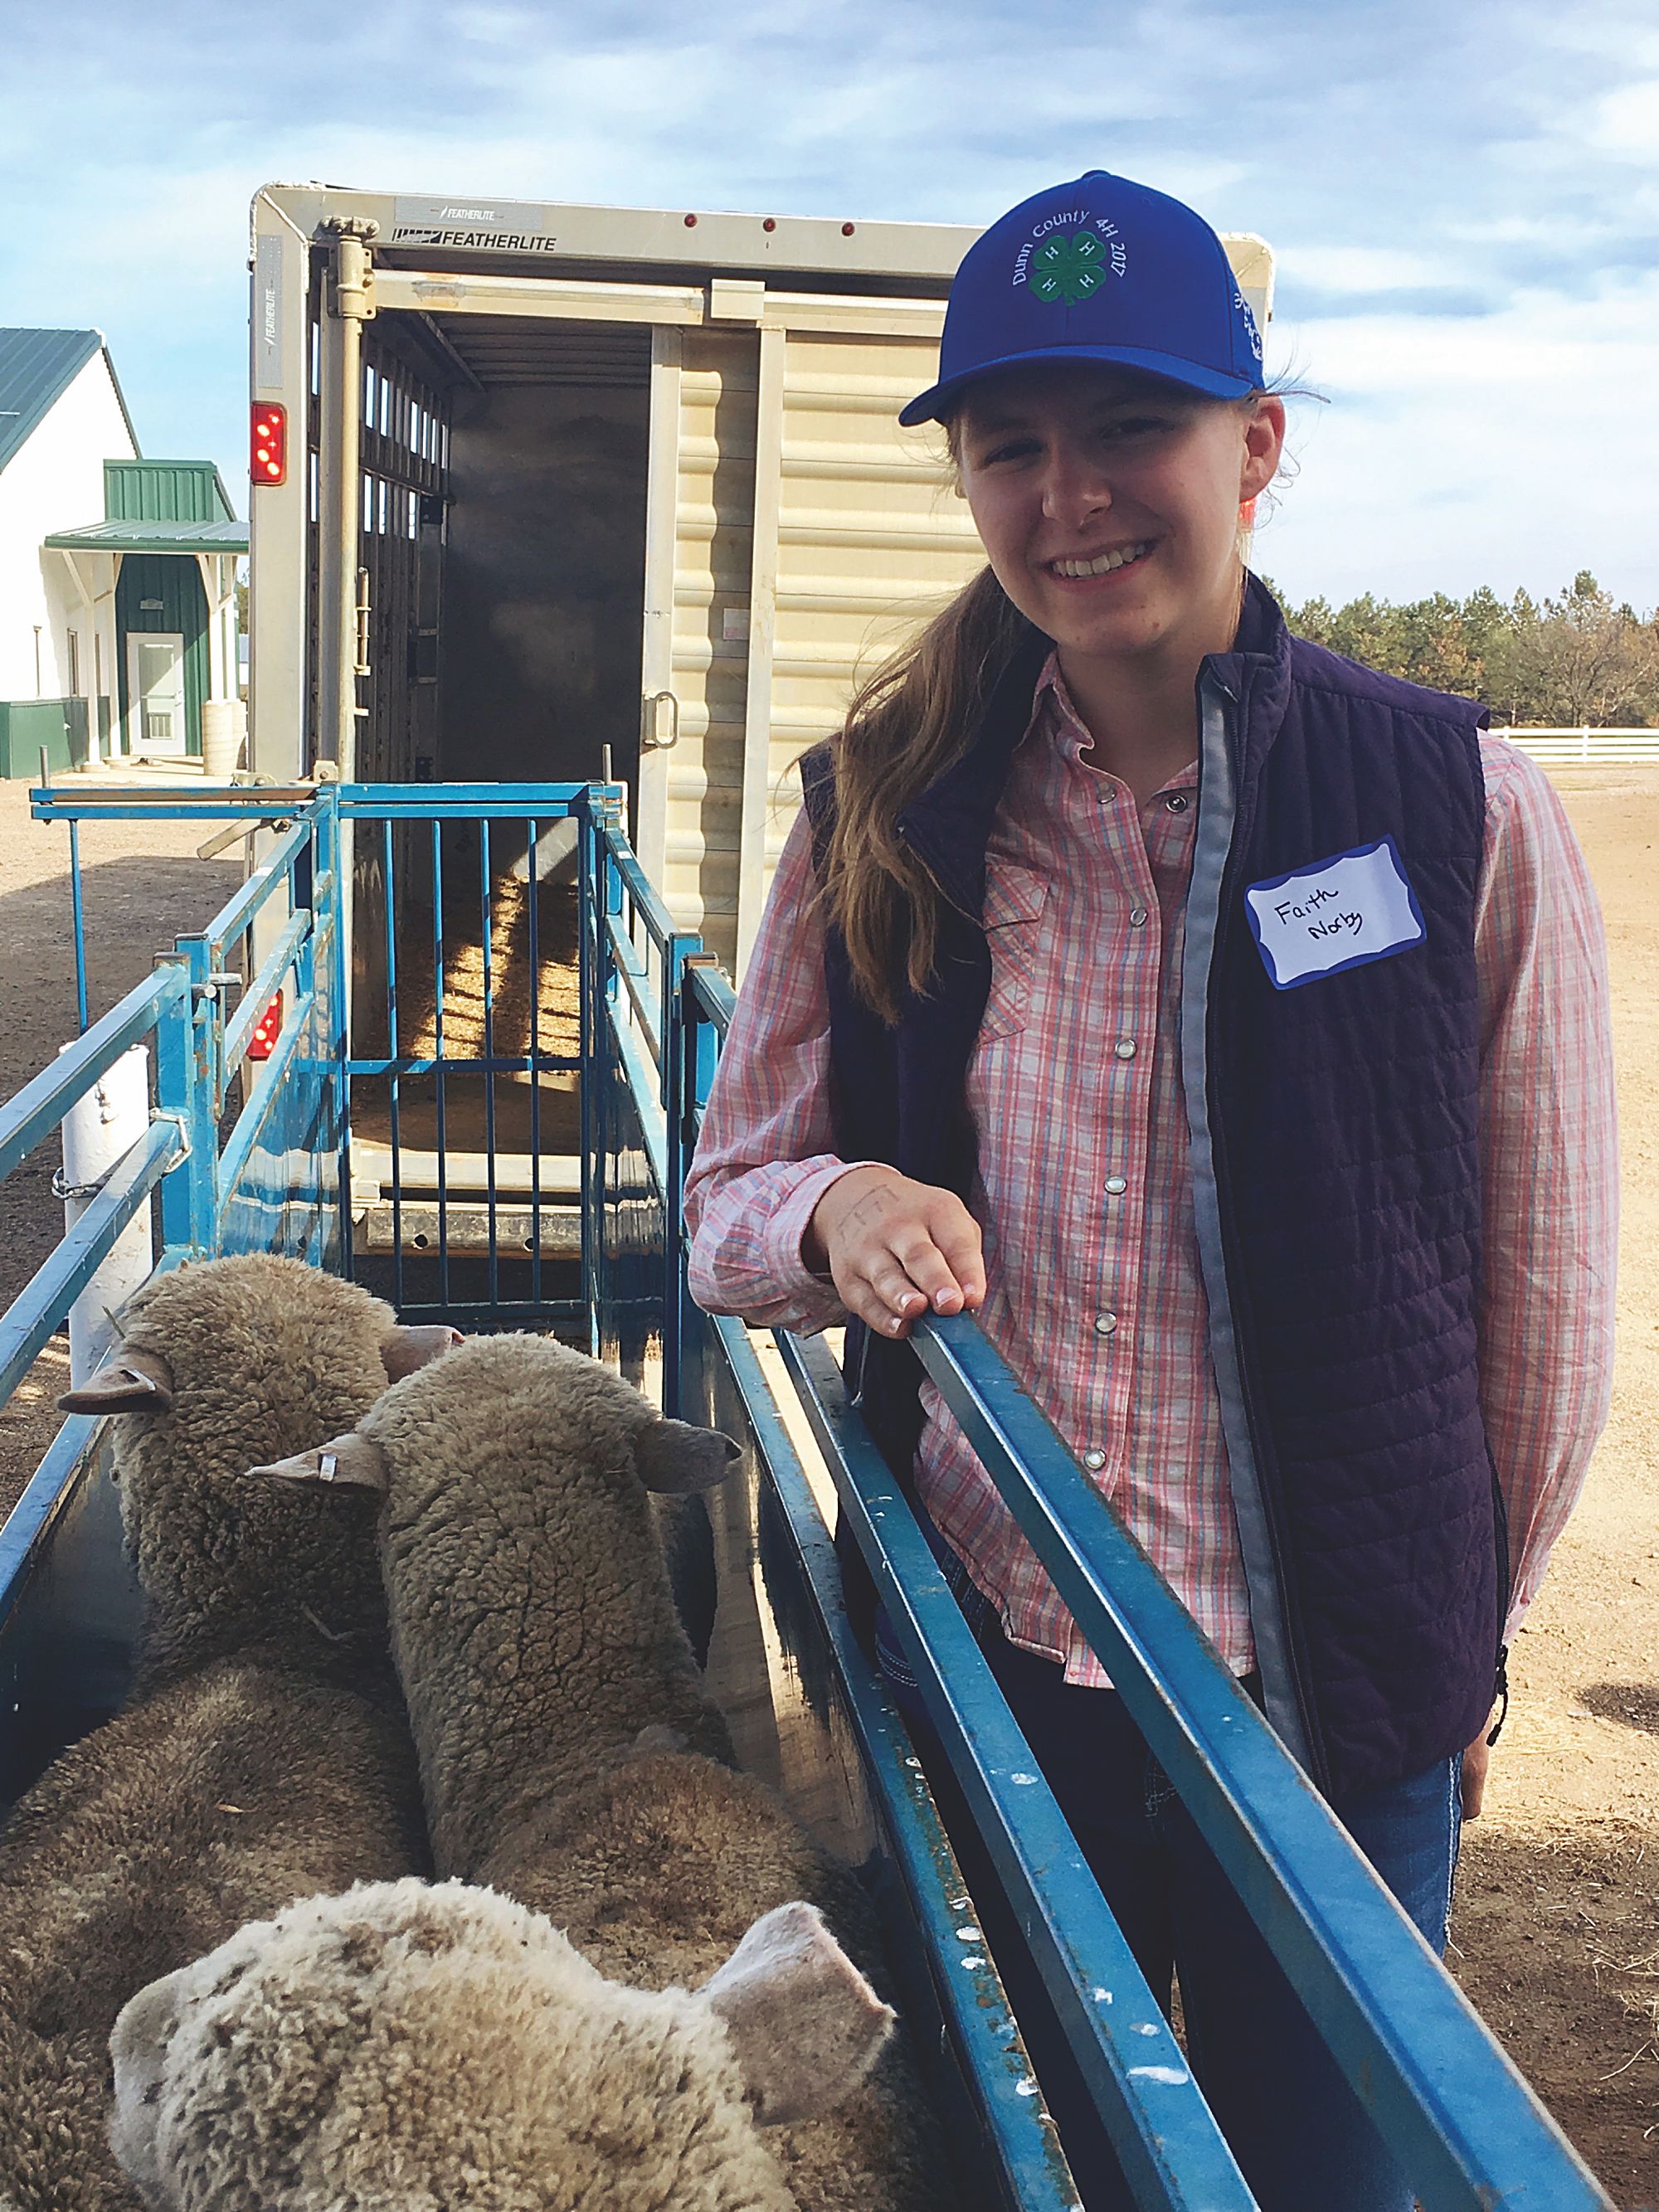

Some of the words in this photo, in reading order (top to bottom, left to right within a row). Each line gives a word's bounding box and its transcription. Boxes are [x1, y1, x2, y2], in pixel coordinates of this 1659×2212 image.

[447, 207, 495, 221] FEATHERLITE
[442, 231, 557, 252] FEATHERLITE
[1012, 242, 1034, 286] Dunn
[1032, 209, 1091, 239] County
[1096, 218, 1119, 238] 4H
[1109, 241, 1127, 278] 2017
[265, 289, 275, 338] FEATHERLITE
[1273, 888, 1340, 926] Faith
[1307, 912, 1364, 940] Norby
